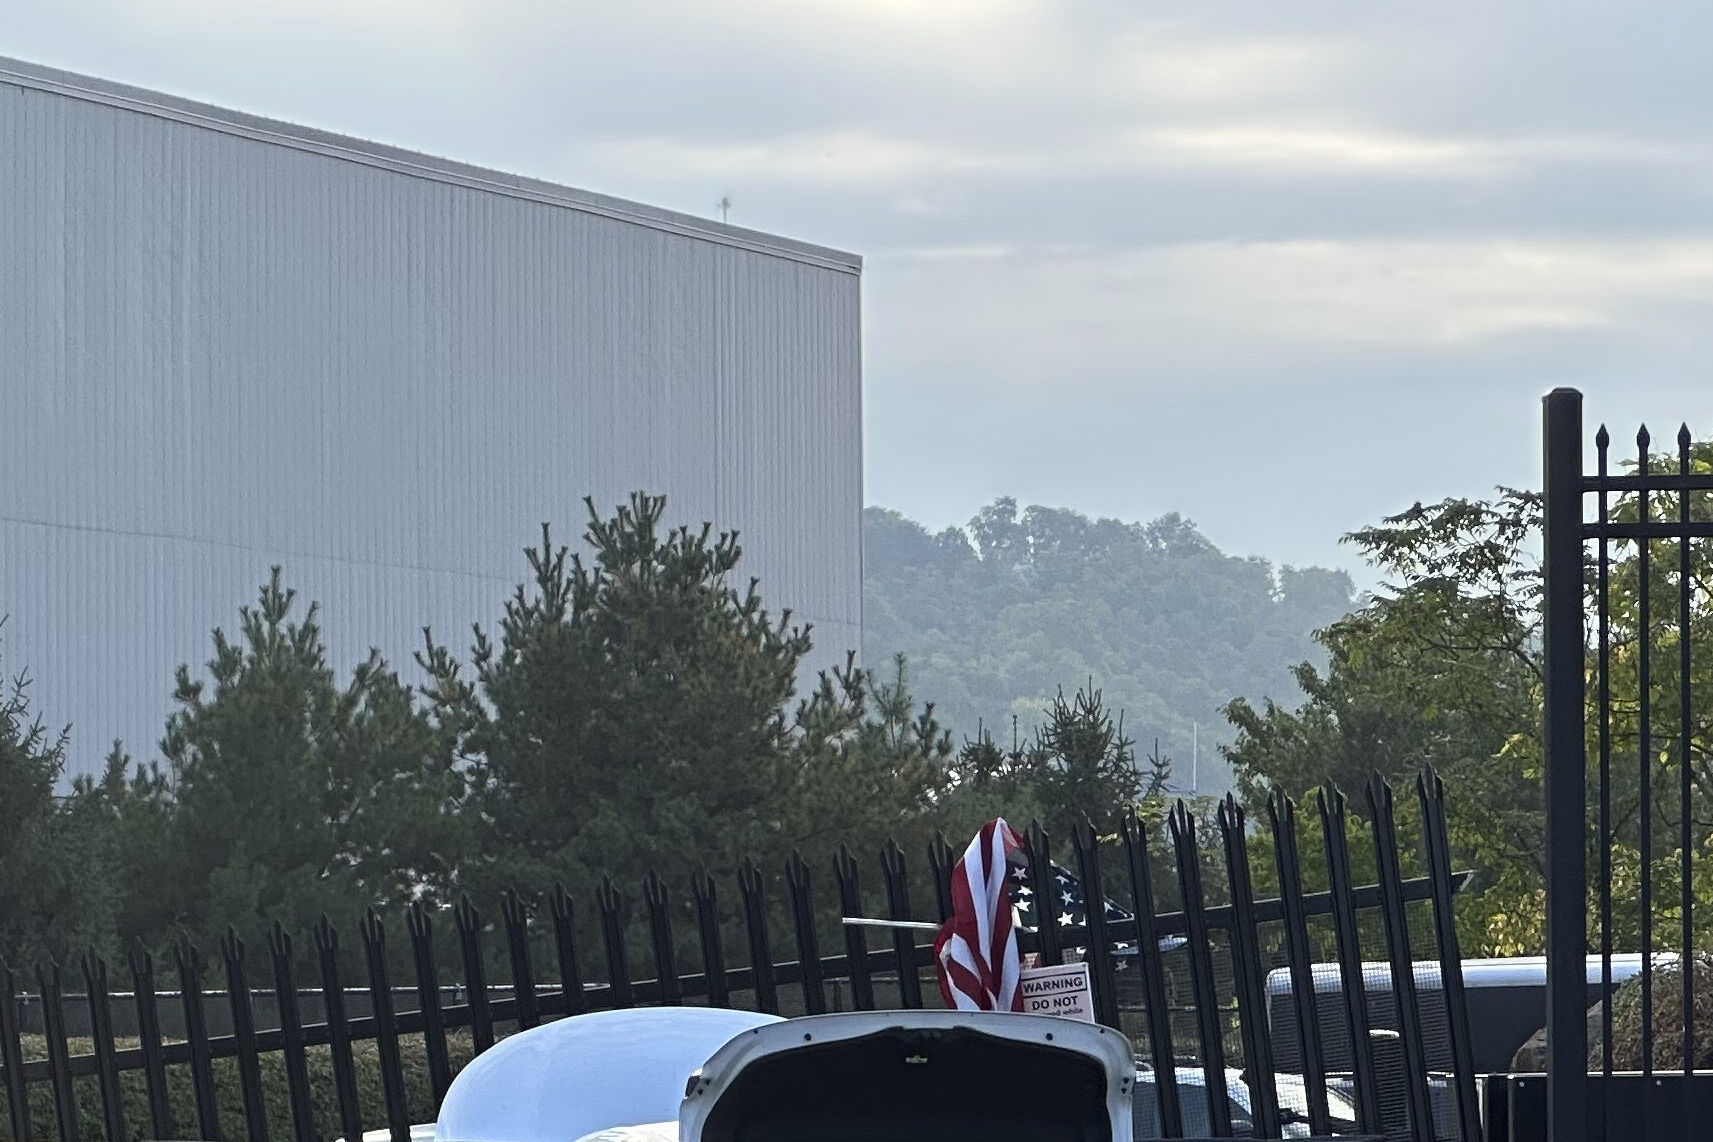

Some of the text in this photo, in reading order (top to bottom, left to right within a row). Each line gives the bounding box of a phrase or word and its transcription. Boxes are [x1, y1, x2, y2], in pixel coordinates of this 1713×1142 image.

[1023, 977, 1083, 994] WARNING
[1032, 996, 1078, 1010] DO NOT
